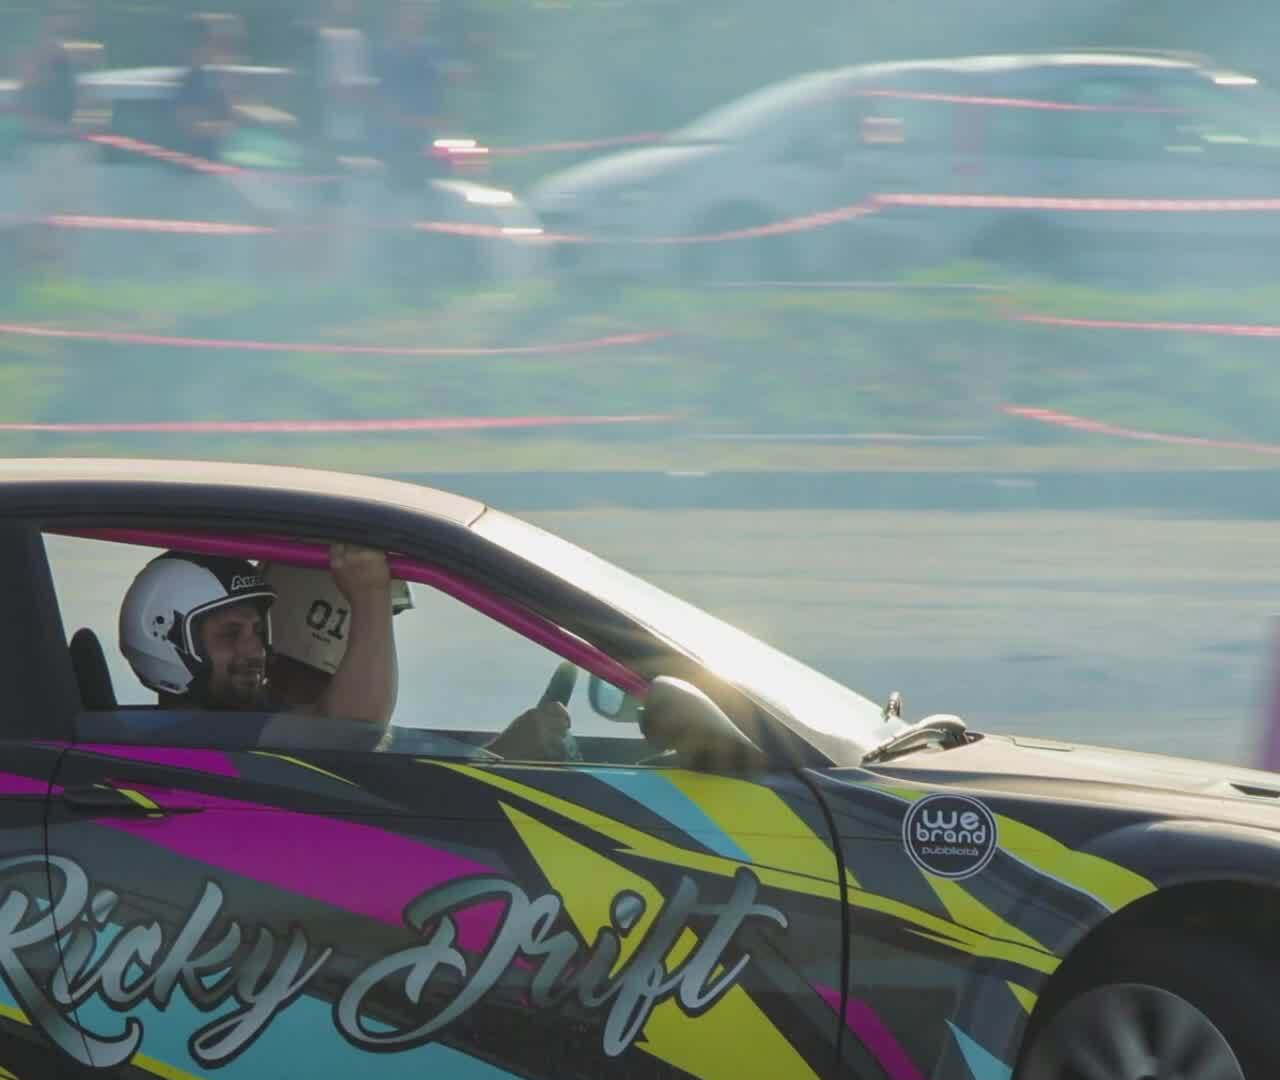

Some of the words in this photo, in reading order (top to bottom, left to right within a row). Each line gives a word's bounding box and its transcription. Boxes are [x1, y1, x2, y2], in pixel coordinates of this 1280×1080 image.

[306, 600, 348, 640] 01
[916, 822, 986, 844] brand
[921, 809, 980, 830] we
[331, 866, 790, 1058] Drift
